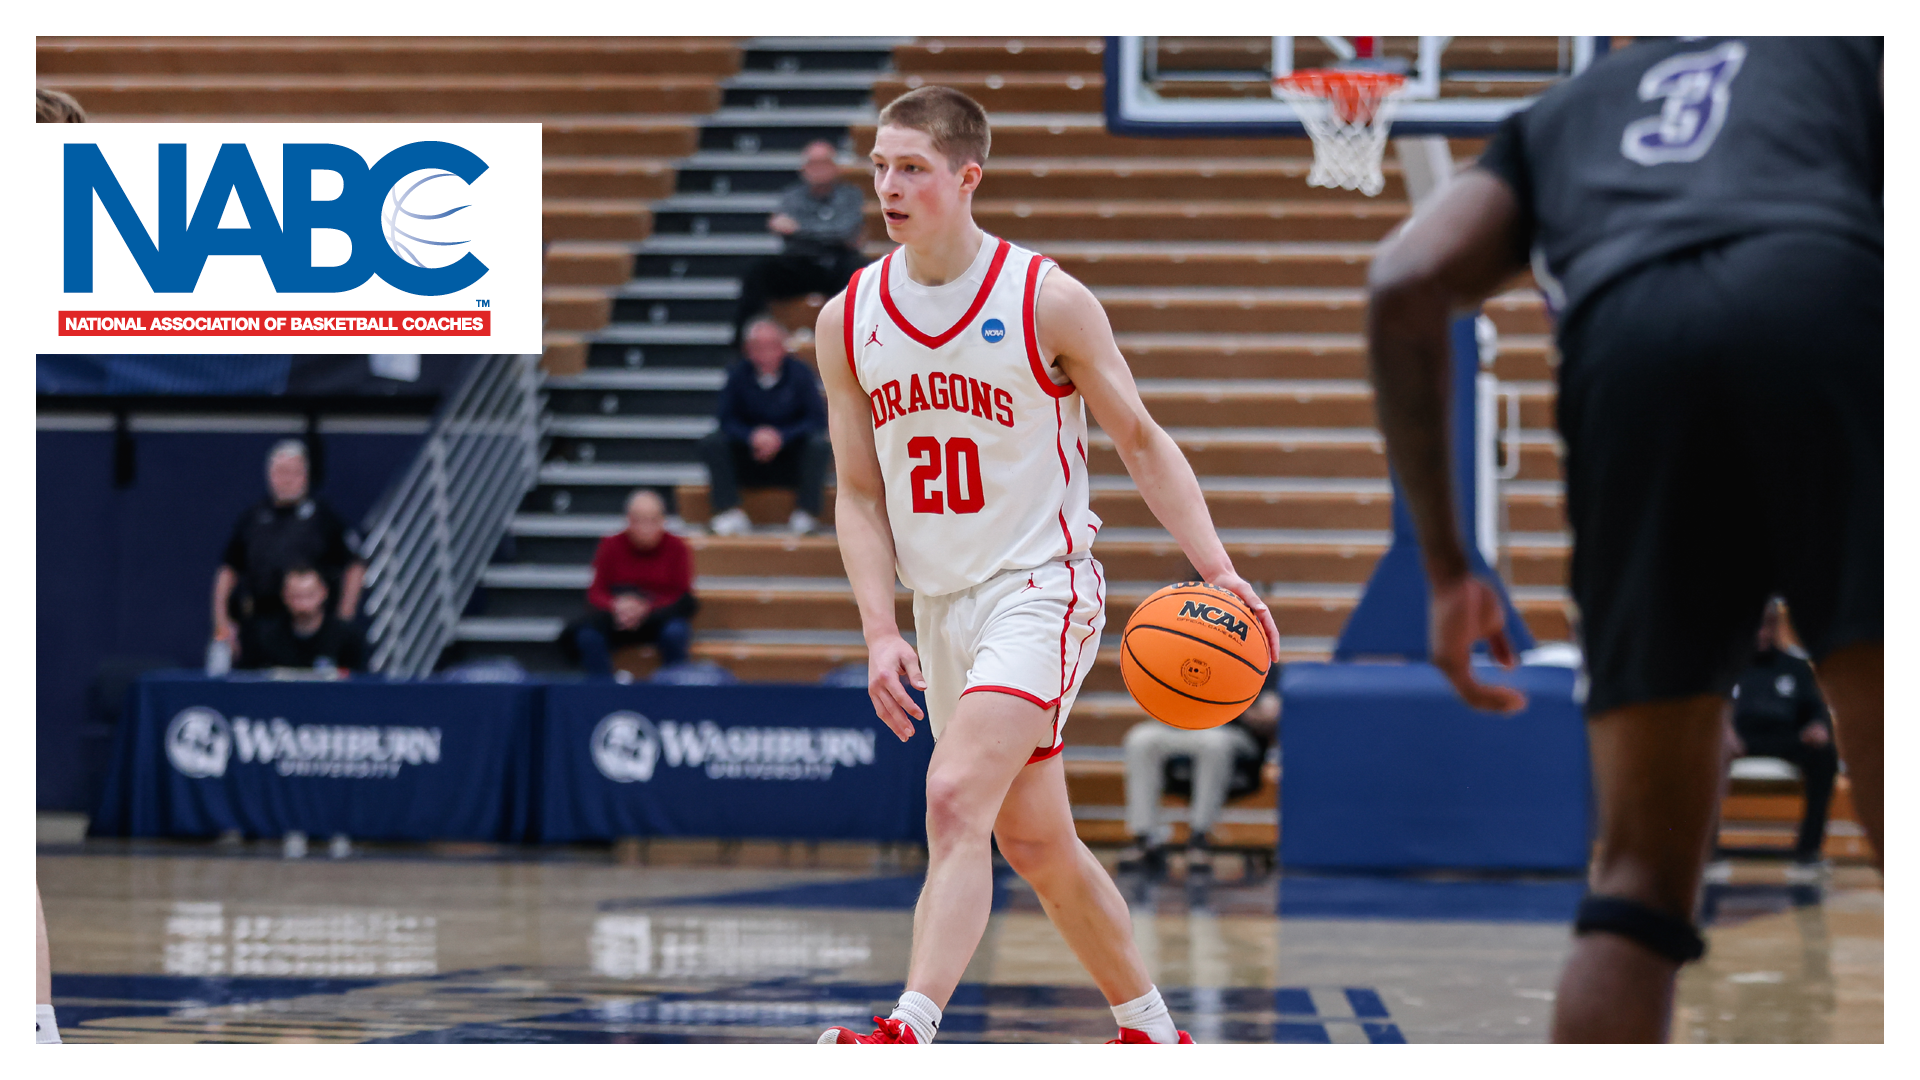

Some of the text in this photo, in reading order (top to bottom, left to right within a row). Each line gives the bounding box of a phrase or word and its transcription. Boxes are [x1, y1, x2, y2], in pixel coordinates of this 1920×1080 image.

[1621, 41, 1748, 166] 3
[870, 371, 1015, 430] DRAGONS
[907, 435, 985, 515] 20
[1177, 600, 1249, 642] NCAA
[1228, 634, 1243, 647] BALL
